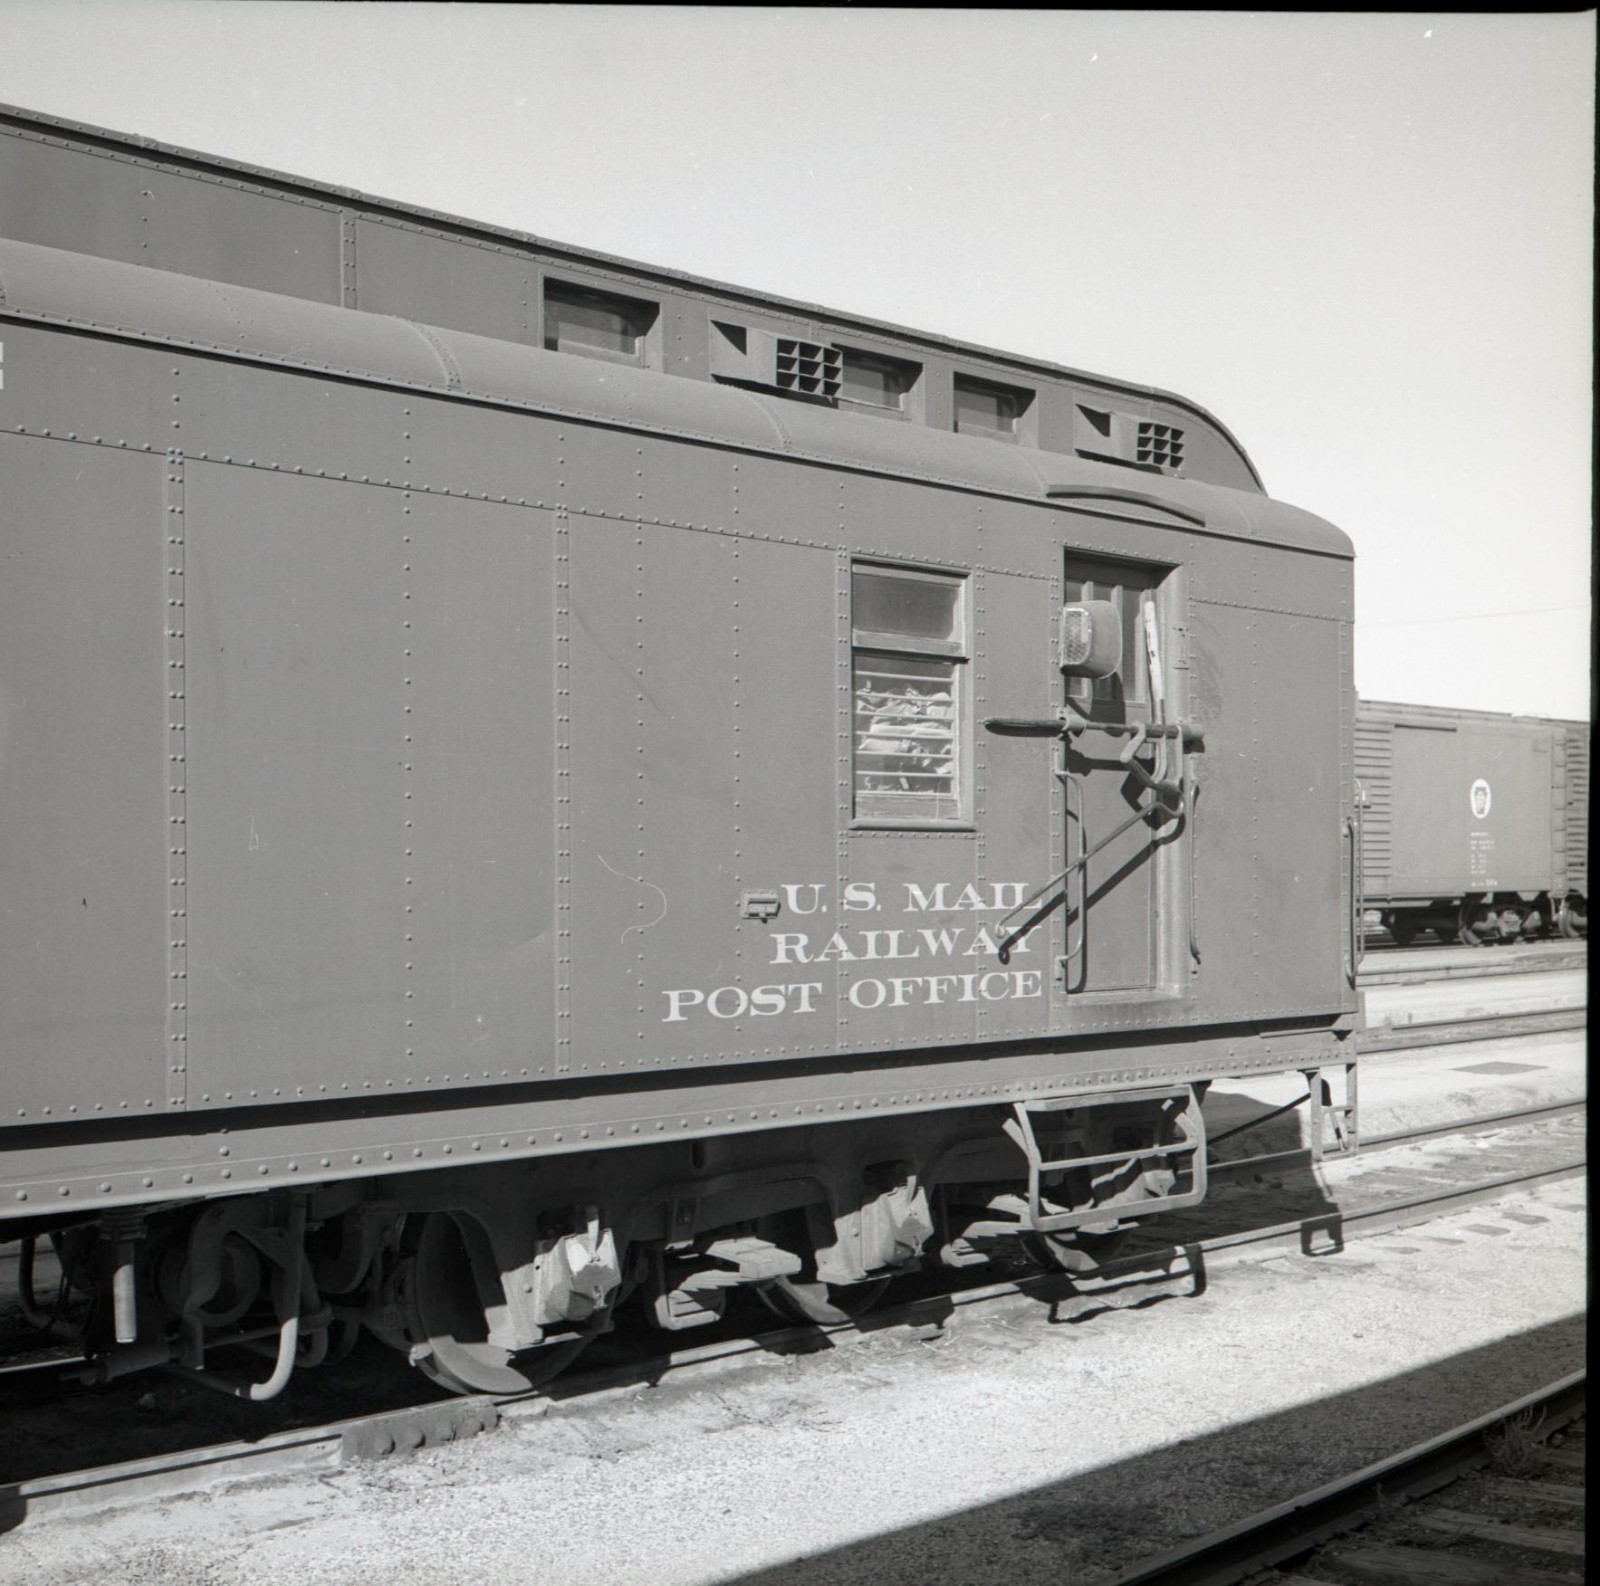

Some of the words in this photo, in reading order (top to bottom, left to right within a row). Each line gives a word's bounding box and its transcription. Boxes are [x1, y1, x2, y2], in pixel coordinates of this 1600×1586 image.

[780, 884, 827, 914] U.
[843, 882, 882, 911] S.
[903, 882, 1042, 912] MAIL
[769, 925, 1042, 964] RAILWAY
[662, 982, 822, 1022] POST
[848, 970, 1042, 1009] OFFICE
